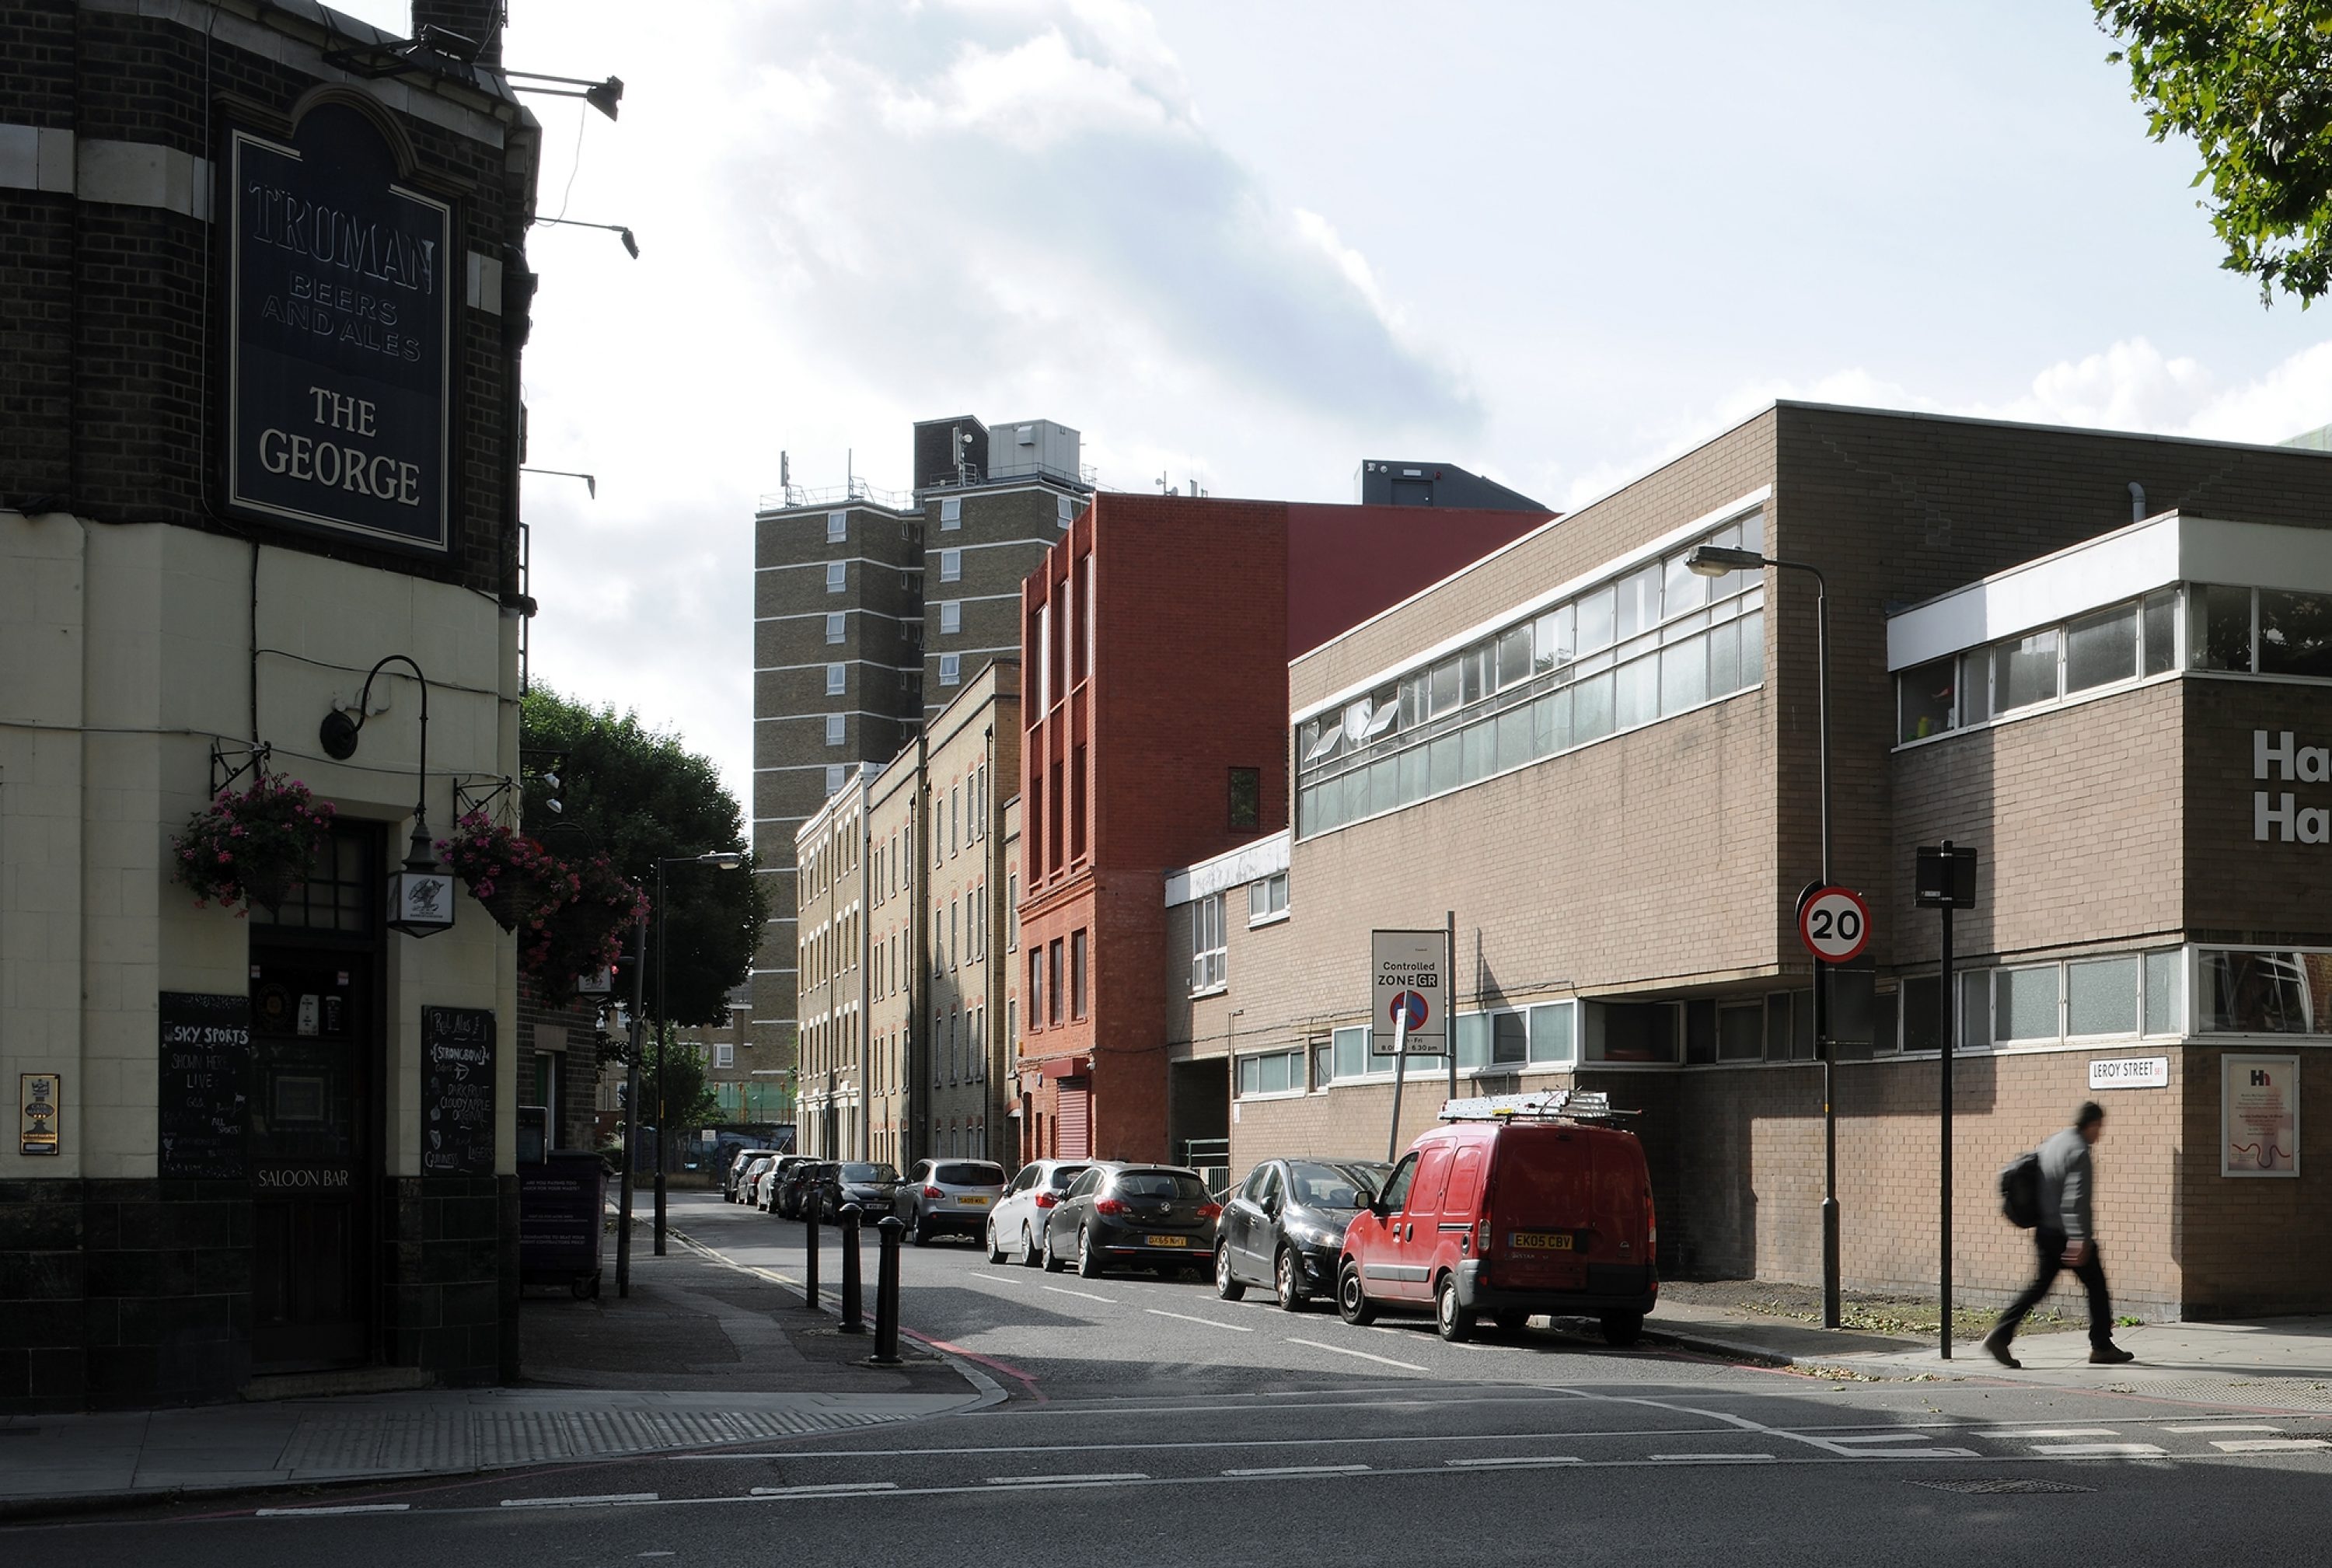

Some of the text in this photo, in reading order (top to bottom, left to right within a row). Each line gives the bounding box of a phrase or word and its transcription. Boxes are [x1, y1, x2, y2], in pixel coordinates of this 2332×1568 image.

[248, 180, 435, 295] TRUMAN
[289, 270, 398, 327] BEERS
[261, 295, 422, 362] AND ALES
[309, 386, 377, 438] THE
[259, 428, 421, 507] GEORGE
[2253, 729, 2332, 783] Ha
[1811, 909, 1860, 940] 20
[1383, 962, 1435, 970] Controlled
[1378, 974, 1437, 987] ZONE GR
[173, 1025, 249, 1045] SKY SPORTS
[171, 1053, 203, 1070] SHOWN
[2093, 1063, 2121, 1077] LEROY
[2123, 1061, 2153, 1077] STREET
[187, 1074, 212, 1088] LIVE
[258, 1169, 349, 1187] SALOON BAR
[1516, 1234, 1571, 1248] EK05 CBV
